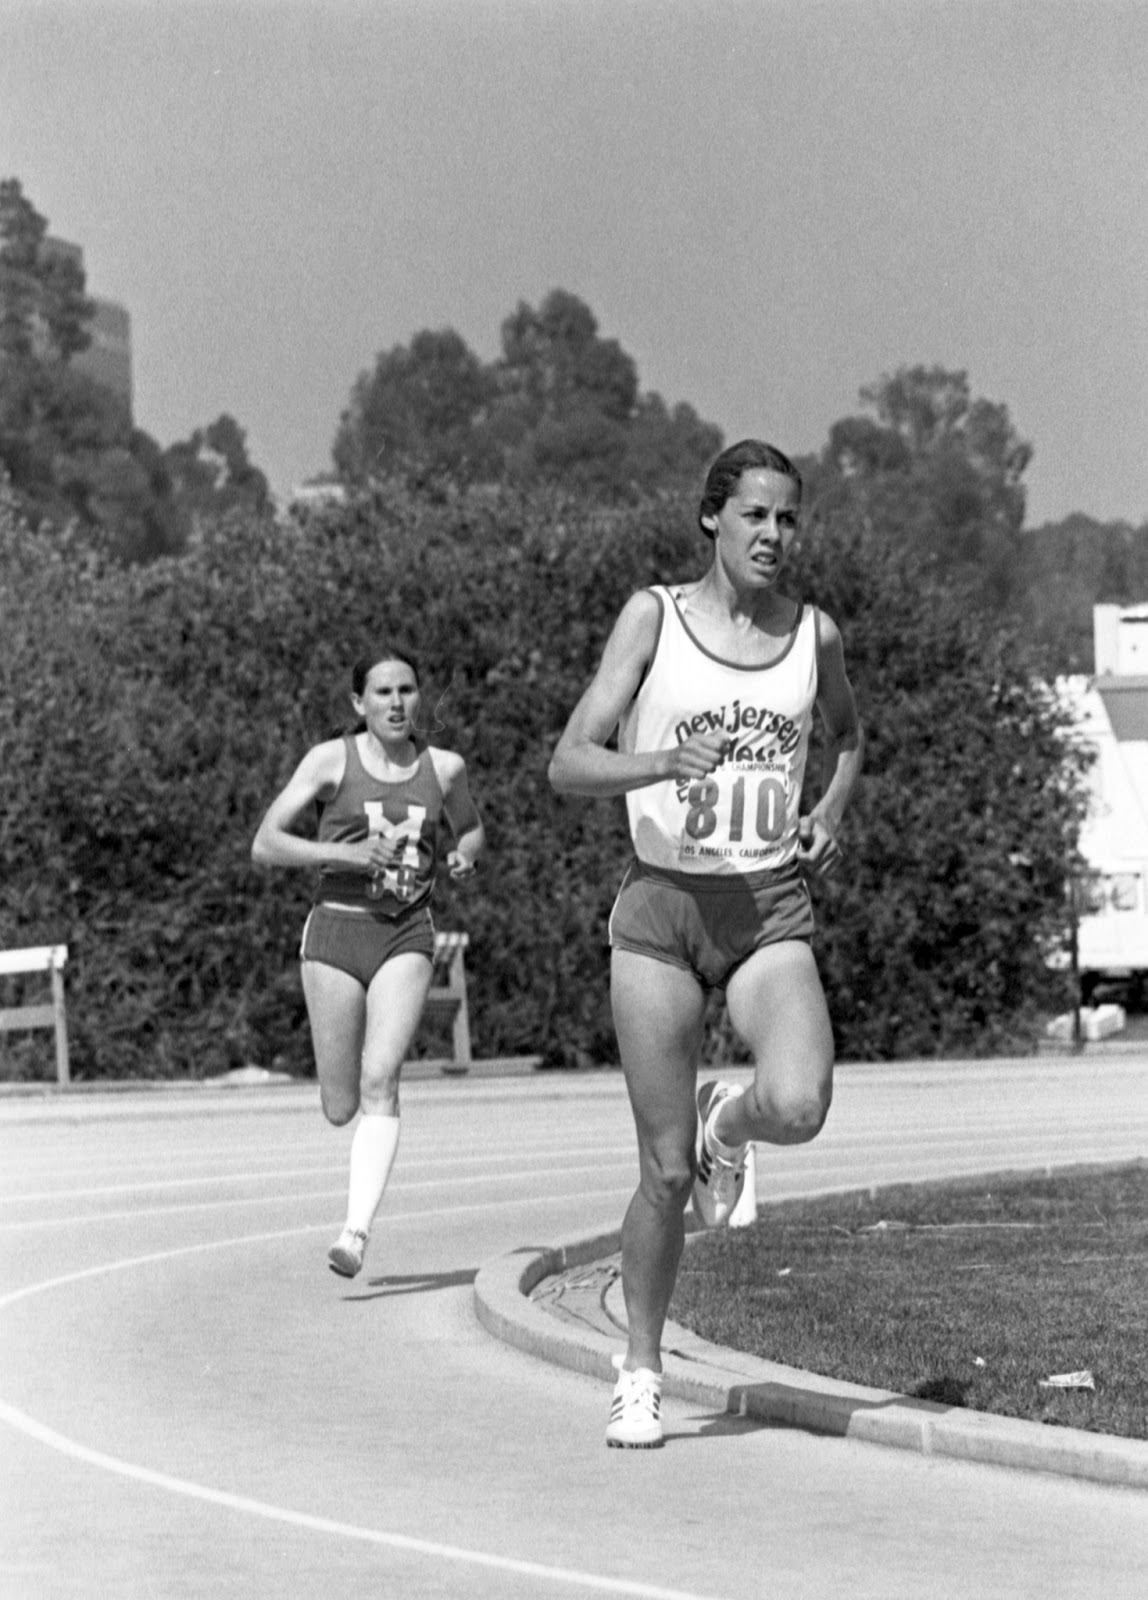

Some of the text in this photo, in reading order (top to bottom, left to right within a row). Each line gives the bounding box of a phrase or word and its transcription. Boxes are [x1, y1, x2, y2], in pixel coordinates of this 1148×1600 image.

[675, 706, 726, 745] new
[726, 699, 801, 755] jersey
[685, 776, 787, 842] 810
